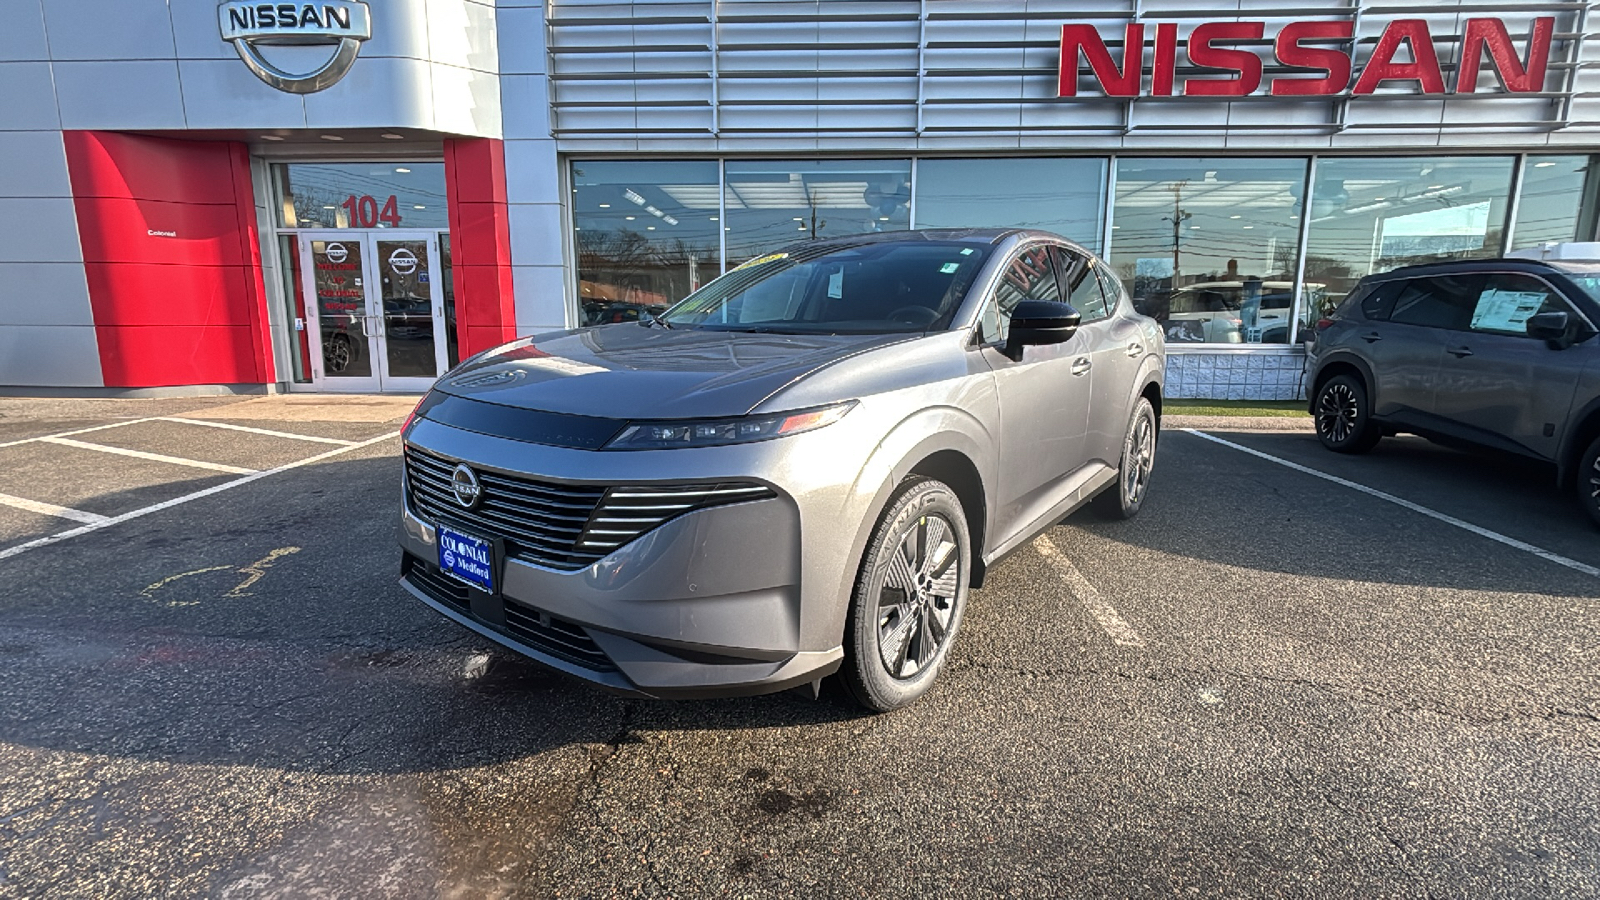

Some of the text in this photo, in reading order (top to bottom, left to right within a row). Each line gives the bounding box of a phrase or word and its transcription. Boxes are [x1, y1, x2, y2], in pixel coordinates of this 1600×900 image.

[228, 4, 350, 30] NISSAN
[1057, 16, 1556, 98] NISSAN
[342, 194, 403, 228] 104
[147, 229, 177, 237] Colonial
[452, 482, 480, 496] SSAN
[882, 502, 918, 557] ALENZA
[440, 534, 491, 566] COLONIAL
[457, 556, 490, 580] Medford
